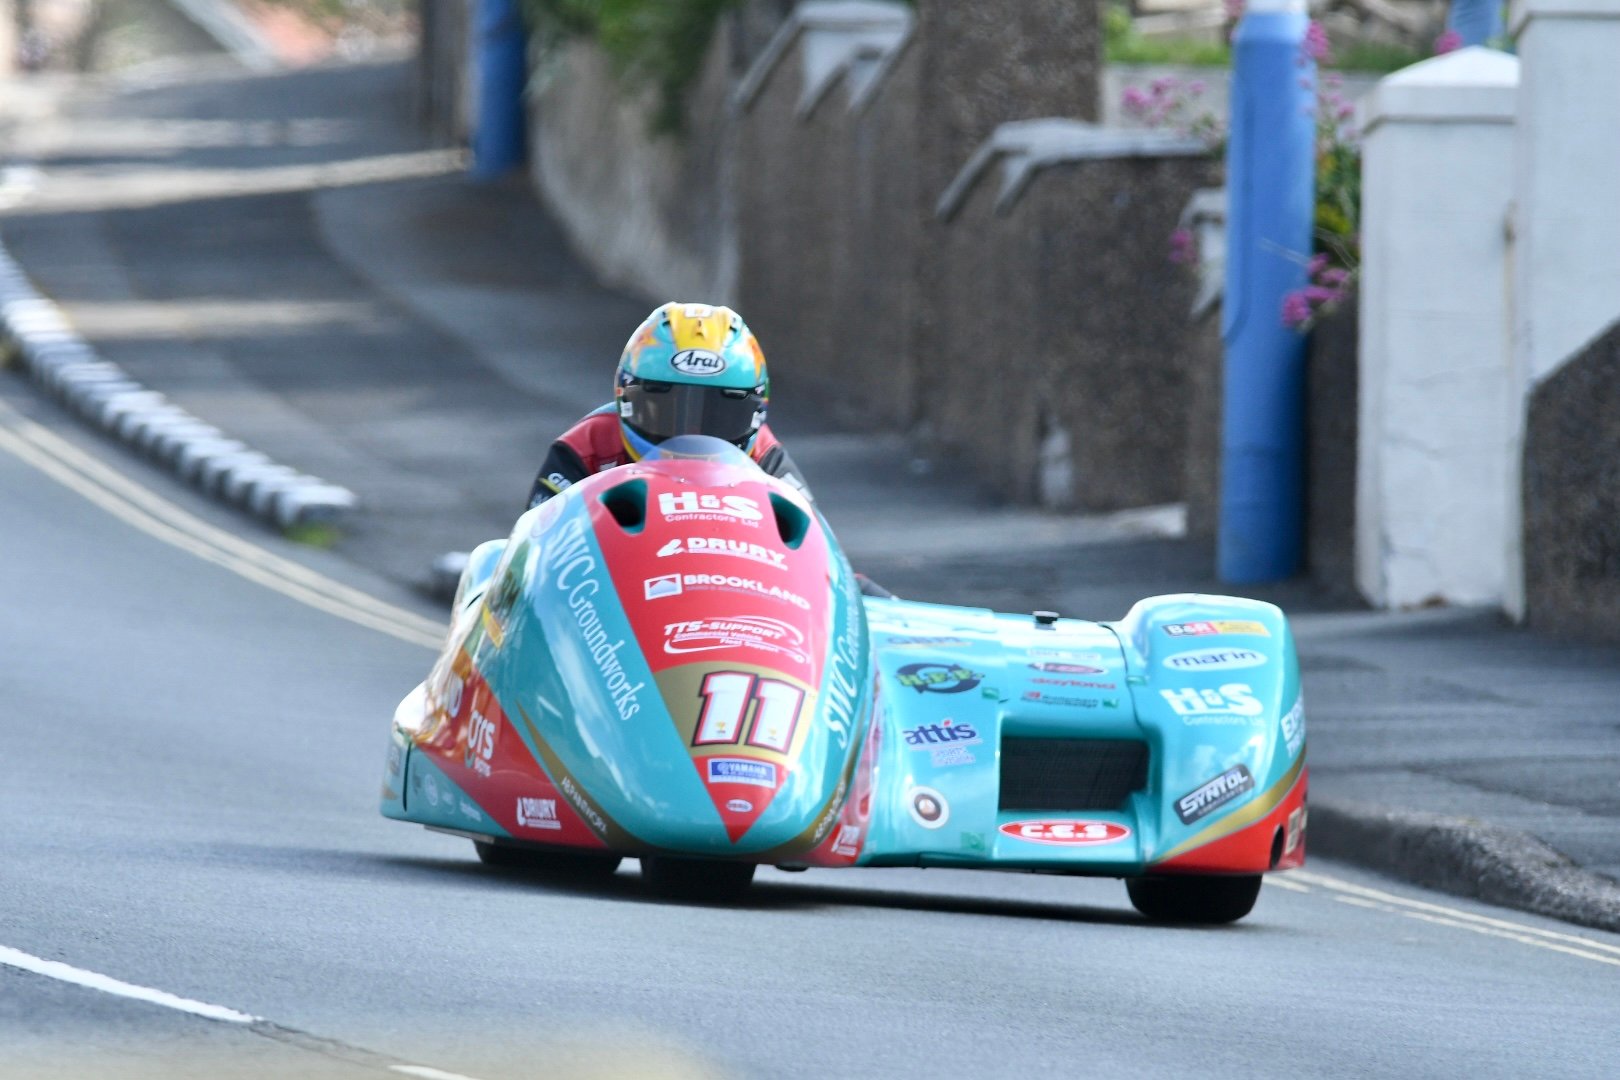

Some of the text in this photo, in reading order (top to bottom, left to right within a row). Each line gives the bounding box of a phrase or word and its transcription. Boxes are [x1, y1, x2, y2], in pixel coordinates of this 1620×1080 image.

[675, 351, 719, 368] Arai
[657, 492, 763, 520] H&S
[550, 517, 596, 590] SWC
[687, 537, 785, 564] DRURY
[684, 574, 811, 609] BROOKLAND
[569, 578, 645, 721] Groundworks
[1172, 651, 1257, 667] marin
[691, 670, 806, 755] 11
[1159, 683, 1264, 716] H&S
[902, 719, 977, 746] attis
[1179, 768, 1249, 817] SYNTOL
